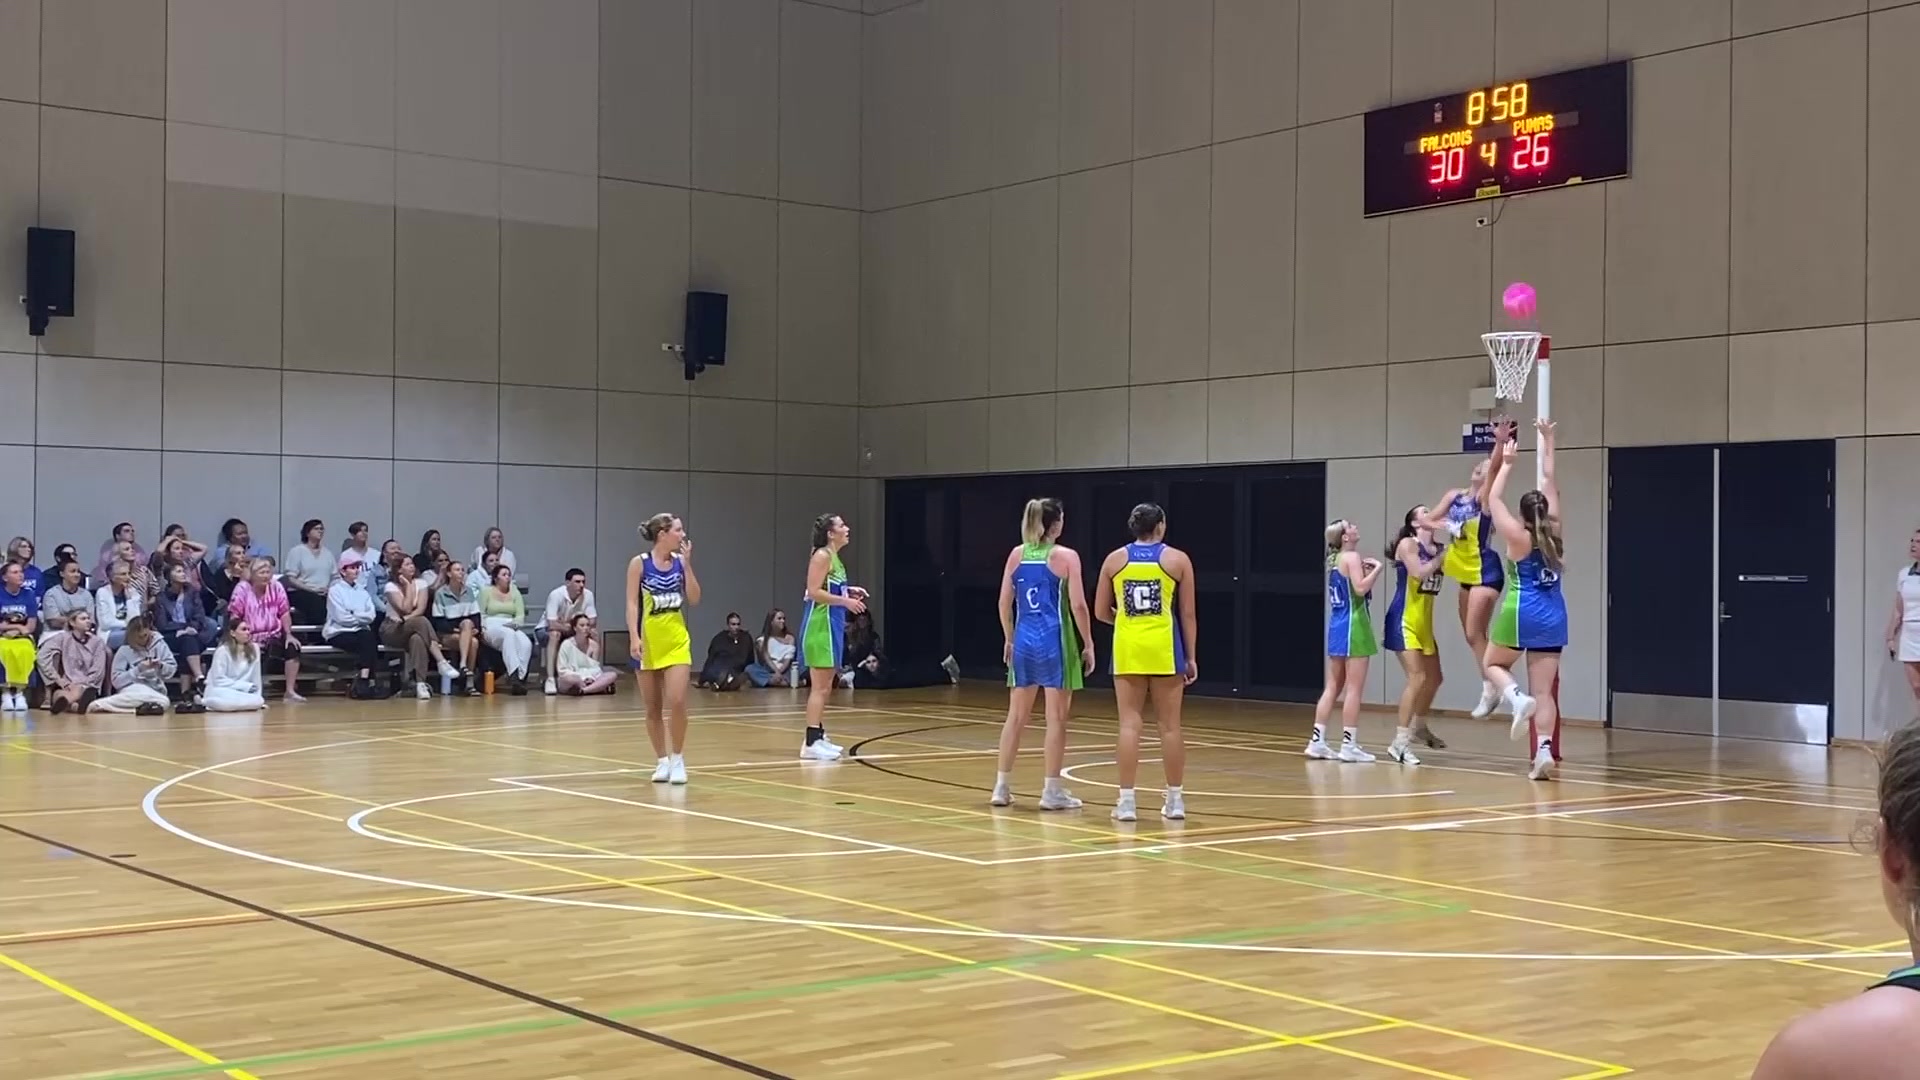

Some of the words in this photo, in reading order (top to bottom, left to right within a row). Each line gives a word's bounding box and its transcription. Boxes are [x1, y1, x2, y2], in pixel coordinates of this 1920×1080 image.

[1466, 82, 1528, 126] 8:58
[1513, 114, 1554, 136] PUMAS
[1420, 129, 1473, 154] FALCONS
[1513, 132, 1550, 170] 26
[1429, 147, 1464, 184] 30
[1480, 142, 1497, 167] 4
[1026, 587, 1039, 608] C
[1133, 586, 1150, 610] C
